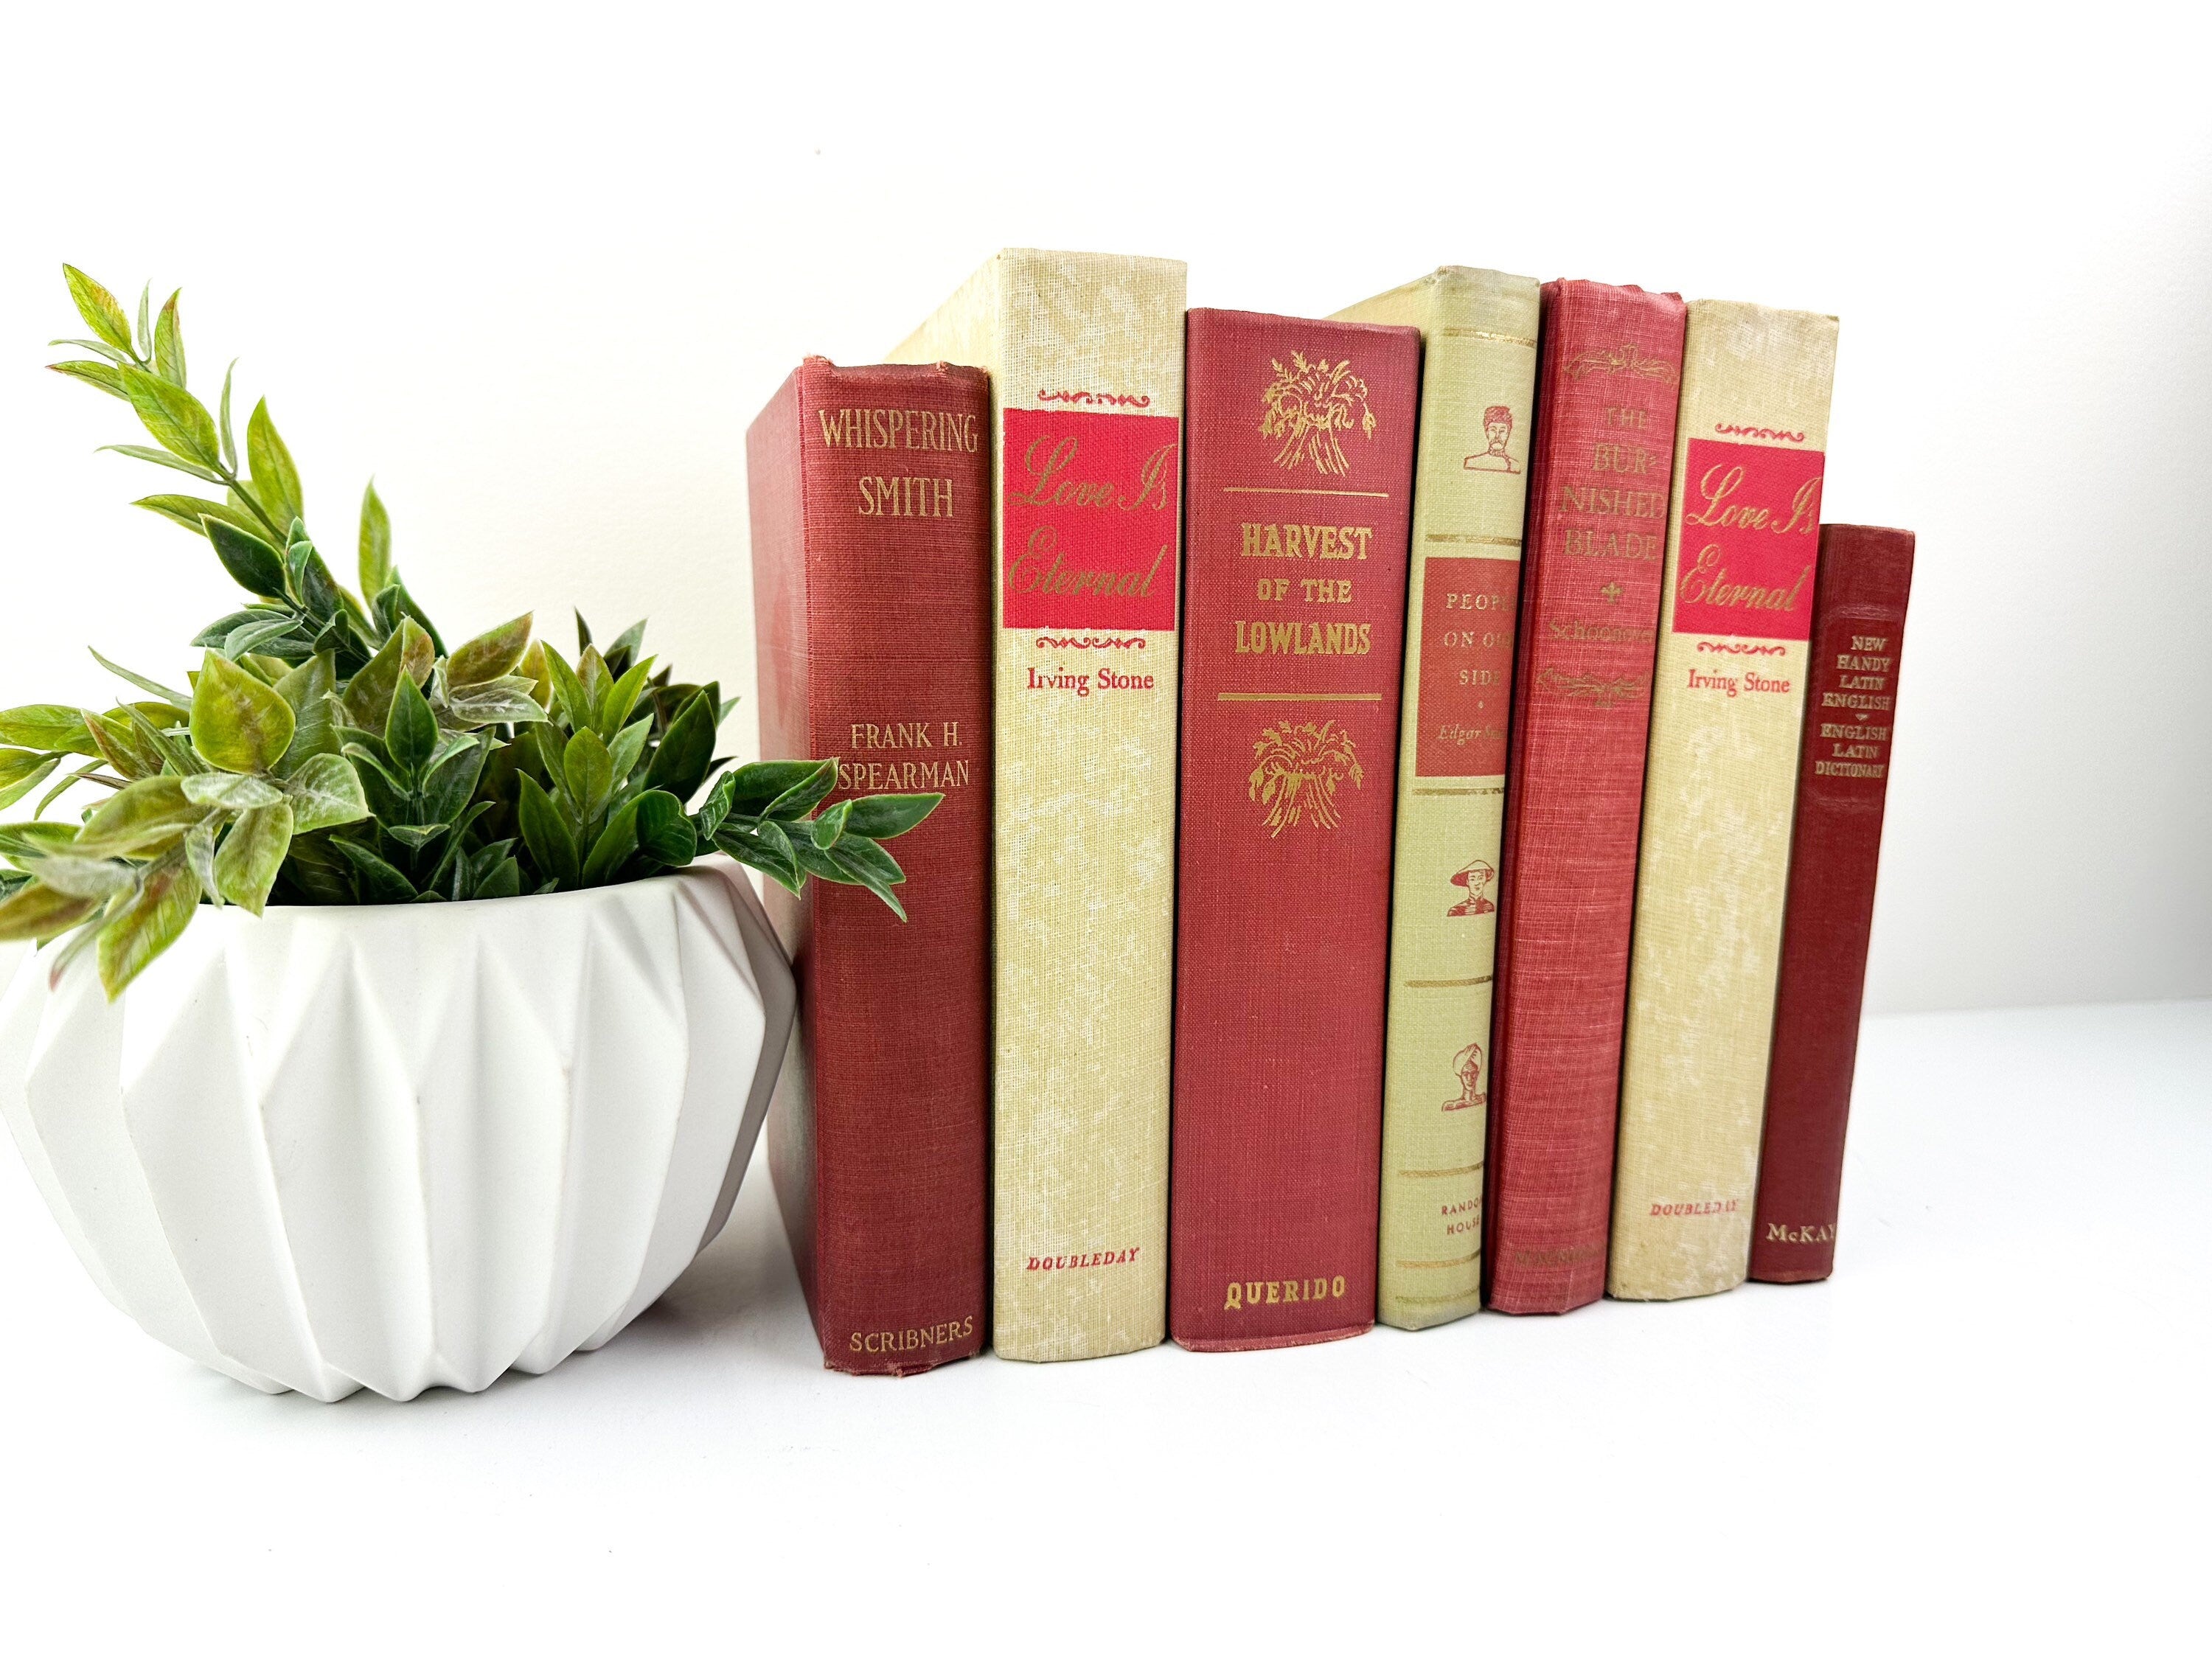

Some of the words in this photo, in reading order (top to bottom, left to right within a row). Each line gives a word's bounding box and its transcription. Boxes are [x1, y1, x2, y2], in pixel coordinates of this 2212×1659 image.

[818, 408, 978, 453] WHISPERING
[1606, 408, 1649, 429] THE
[1008, 434, 1116, 507] Love
[1118, 444, 1178, 511] Is
[858, 476, 955, 517] SMITH
[1560, 486, 1666, 519] NISHED
[1686, 464, 1771, 530] Love
[1772, 476, 1823, 535] Is
[1241, 522, 1373, 560] HARVEST
[1562, 528, 1658, 561] BLADE
[1008, 525, 1168, 598] Eternal
[1258, 578, 1290, 602] OF
[1301, 579, 1353, 604] THE
[1678, 543, 1811, 613] Eternal
[1234, 620, 1371, 655] LOWLANDS
[1444, 631, 1475, 647] ON
[1851, 635, 1888, 652] NEW
[1836, 654, 1891, 672] HANDY
[1028, 667, 1090, 697] Irving
[1097, 669, 1154, 690] Stone
[1458, 670, 1500, 686] SIDE
[1687, 669, 1739, 697] Irving
[1744, 673, 1790, 694] Stone
[1839, 675, 1885, 690] LATIN
[1821, 692, 1891, 711] ENGLISH
[851, 722, 933, 749] FRANK
[1436, 723, 1482, 745] Edgar
[1820, 723, 1887, 741] ENGLISH
[1832, 742, 1878, 759] LATIN
[838, 759, 970, 790] SPEARMAN
[1815, 760, 1885, 779] DICTIONARY
[1447, 1214, 1480, 1235] HOUSE
[1765, 1222, 1837, 1244] McKAY
[1026, 1246, 1141, 1271] DOUBLEDAY
[1223, 1275, 1346, 1311] QUERIDO
[848, 1315, 974, 1354] SCRIBNERS
